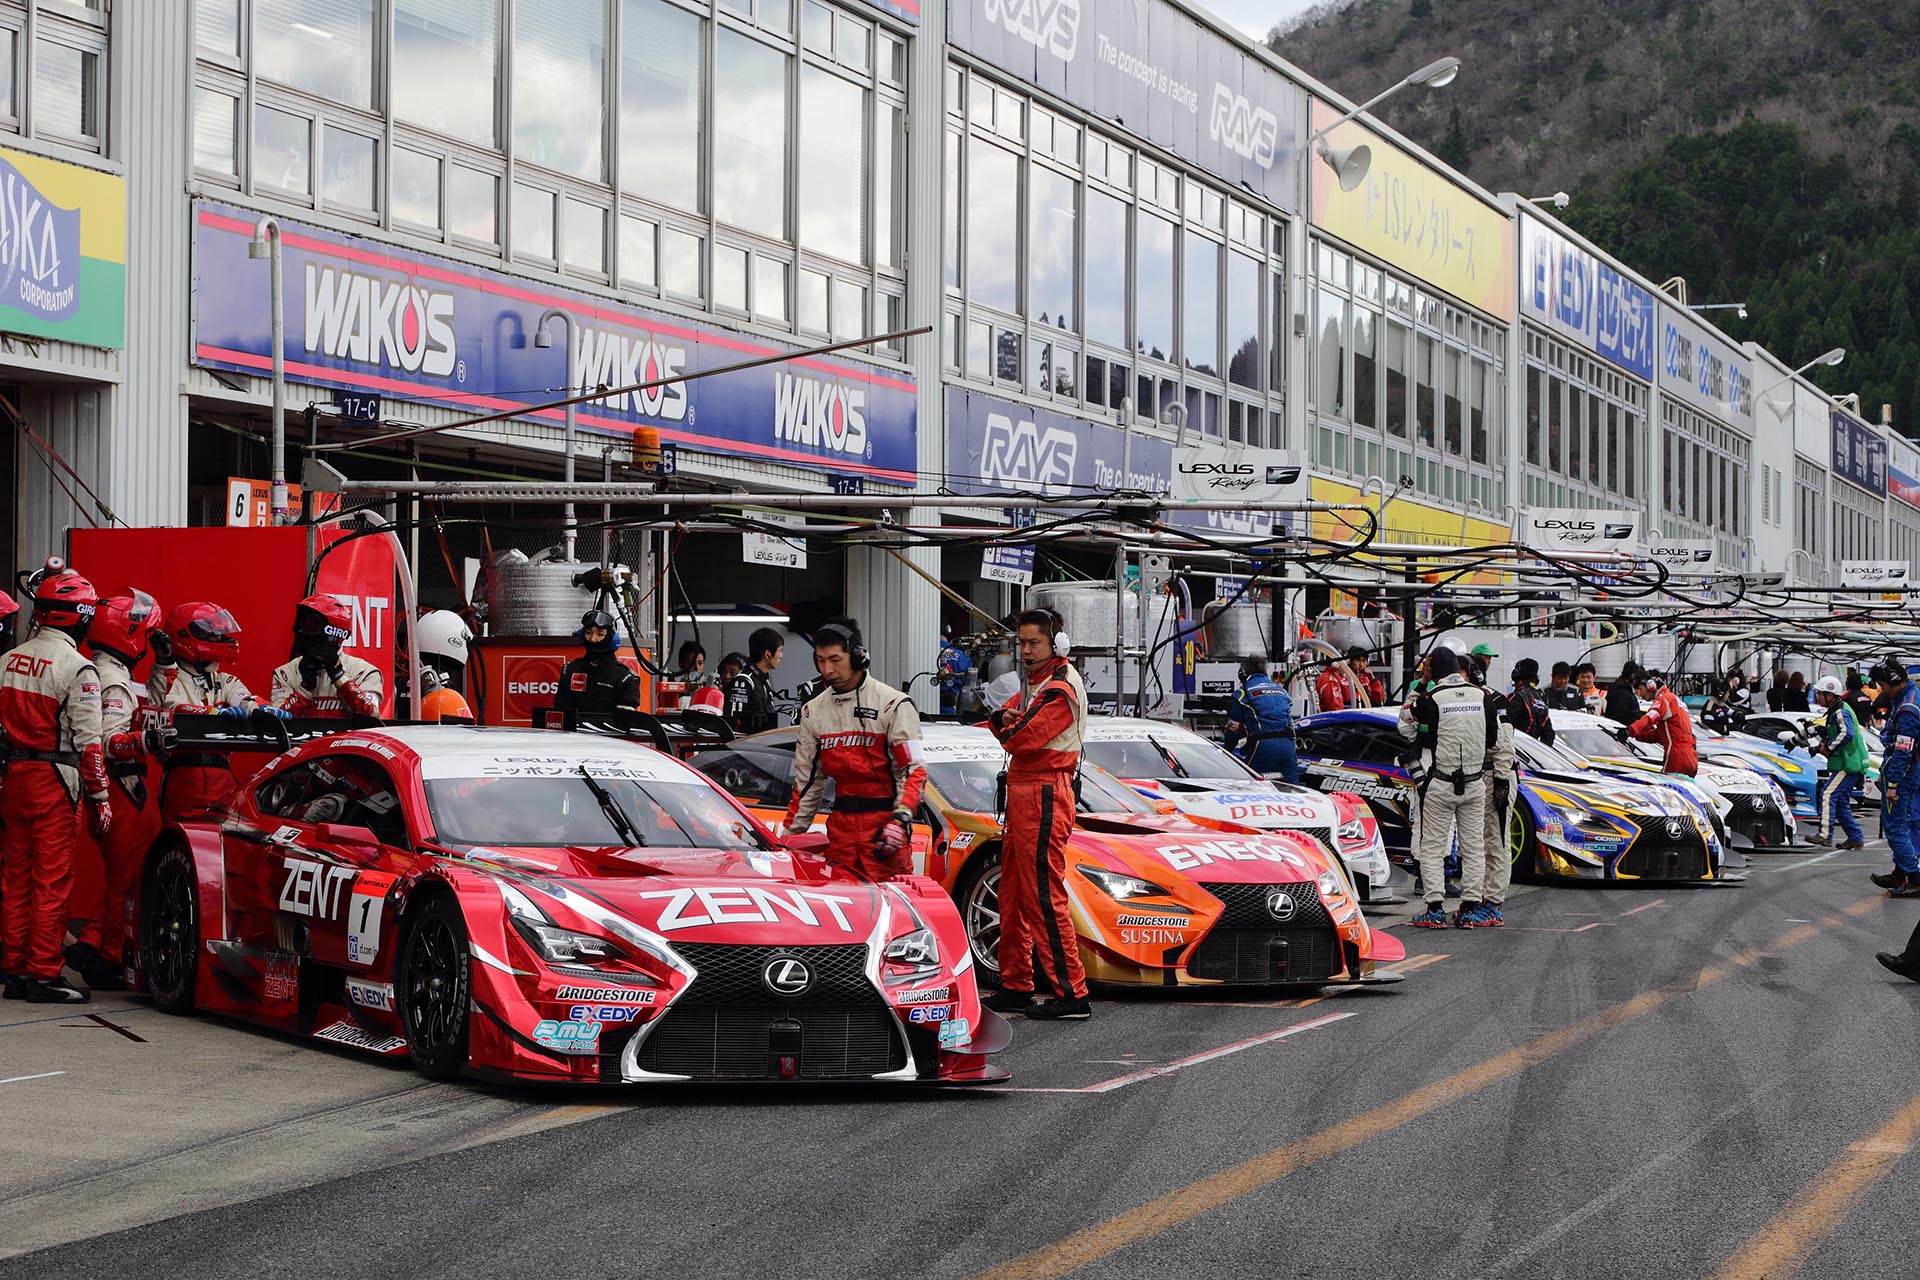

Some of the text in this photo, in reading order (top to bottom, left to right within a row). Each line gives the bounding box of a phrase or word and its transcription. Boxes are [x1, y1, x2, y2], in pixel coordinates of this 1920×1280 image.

[1098, 33, 1198, 113] The concept is racing.
[1210, 82, 1277, 170] RAYS
[1534, 234, 1594, 336] EXEDY
[20, 277, 74, 312] CORPORATION
[980, 412, 1077, 495] RAYS
[1095, 459, 1113, 487] The
[1115, 469, 1156, 492] cncept
[1179, 463, 1255, 475] LEXUS
[1208, 476, 1262, 491] Racing
[253, 487, 268, 498] LEXUS
[235, 493, 244, 518] 6
[1534, 519, 1596, 531] LEXUS
[1650, 548, 1689, 556] LEXUS
[1845, 567, 1883, 575] LEXUS
[324, 624, 349, 639] GIRO
[6, 653, 53, 679] ZENT
[508, 682, 560, 694] ENEOS
[1442, 705, 1482, 713] BRIDGESTONE
[1320, 776, 1409, 801] WedsSport
[1229, 805, 1317, 820] DENSO
[1155, 842, 1306, 872] ENEOS
[279, 858, 356, 921] ZENT
[360, 898, 372, 934] 1
[640, 887, 854, 933] ZENT
[1118, 915, 1188, 927] BRIDGESTONE
[1120, 929, 1184, 944] SUSTINA
[264, 977, 298, 1000] ZENT
[351, 985, 387, 1008] EXEDY
[557, 986, 654, 1003] BRIDGESTONE
[898, 988, 949, 1003] BRIDGESTONE
[571, 1006, 640, 1021] EXEDY
[910, 1006, 951, 1021] EXEDY
